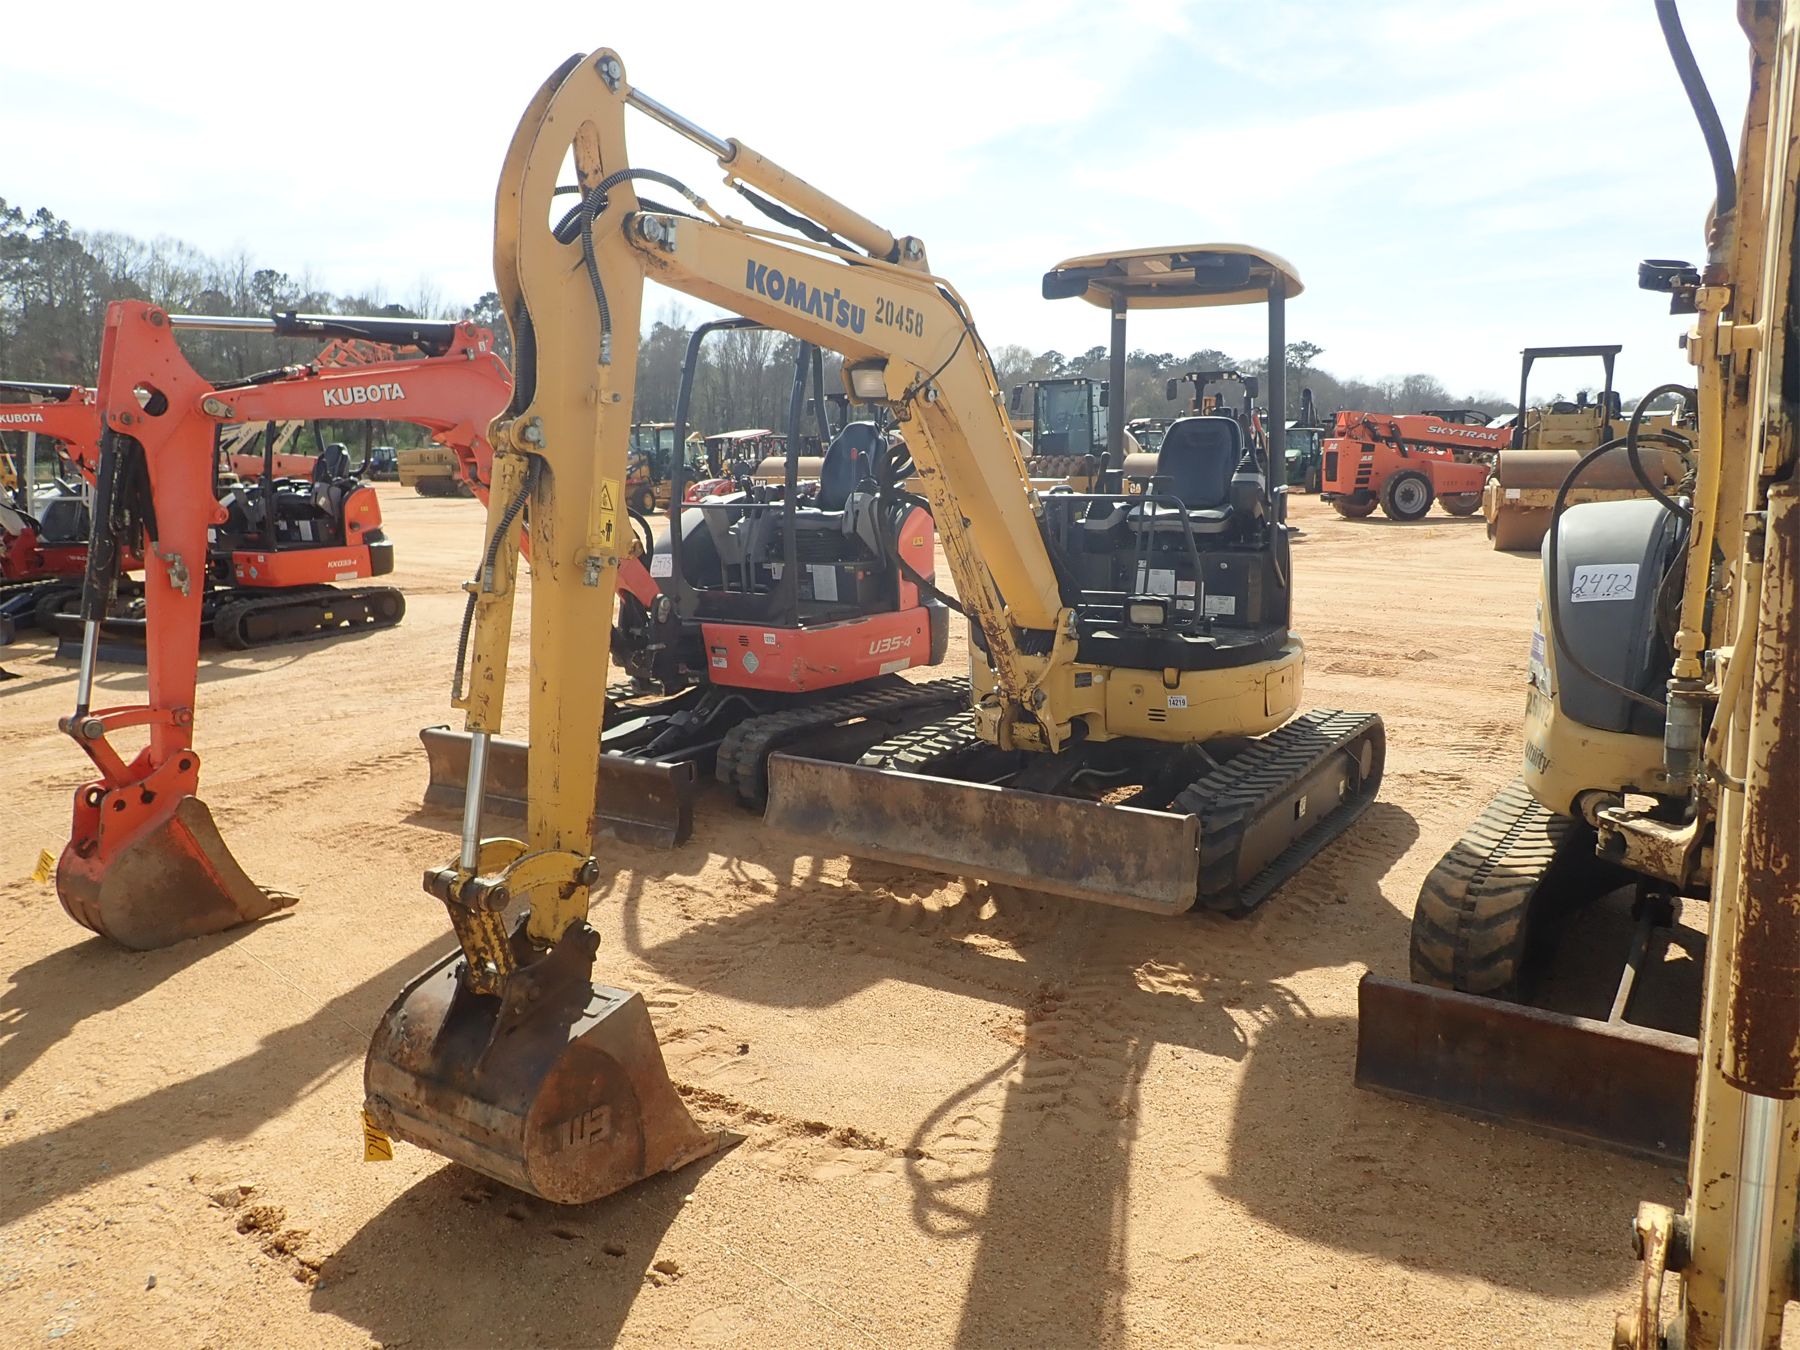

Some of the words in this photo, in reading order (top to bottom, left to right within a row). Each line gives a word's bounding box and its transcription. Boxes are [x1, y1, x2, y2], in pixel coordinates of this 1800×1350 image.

[746, 258, 866, 335] KOMATSU
[875, 297, 924, 338] 20458
[324, 382, 406, 408] KUBOTA
[0, 413, 43, 423] KUBOTA
[1426, 423, 1499, 442] SKYTRAK
[1129, 482, 1142, 494] CA
[1570, 573, 1634, 595] 2472
[869, 634, 913, 656] U35-4
[1168, 698, 1186, 706] 14219
